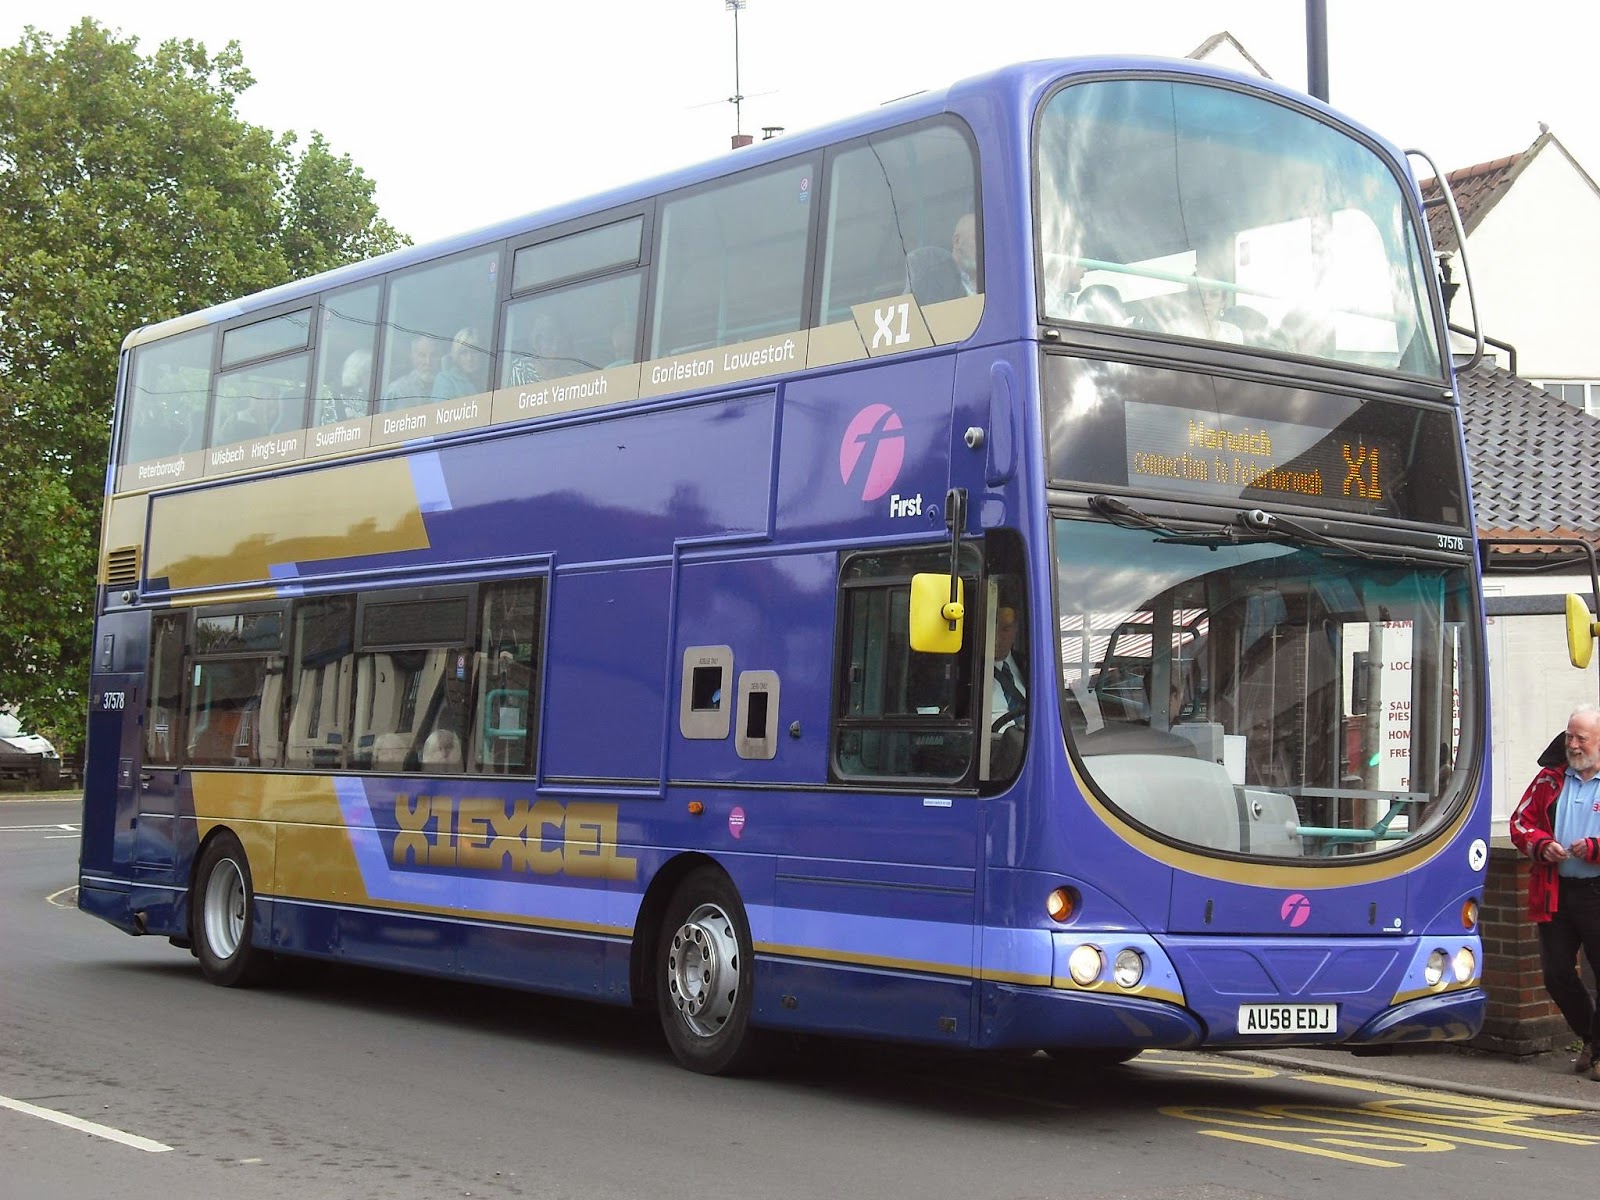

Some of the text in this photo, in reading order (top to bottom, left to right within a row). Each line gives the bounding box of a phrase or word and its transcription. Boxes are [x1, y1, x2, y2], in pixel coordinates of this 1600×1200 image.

[872, 303, 910, 349] X1
[652, 339, 795, 384] Gorleston Lowestoft
[518, 377, 608, 409] Great Yarmouth
[383, 402, 478, 434] Dereham Norwich
[316, 426, 361, 447] Swaffham
[1188, 420, 1272, 456] Norwich
[211, 446, 244, 466] Wisbech
[277, 438, 297, 456] Lynn
[138, 458, 185, 479] Peterborough
[1215, 456, 1229, 484] to
[1233, 458, 1323, 496] Peterborough
[1343, 443, 1383, 499] X1
[890, 493, 922, 518] First
[1437, 535, 1464, 551] 37578
[103, 692, 125, 710] 37578
[1247, 1007, 1330, 1031] AU58 EDJ
